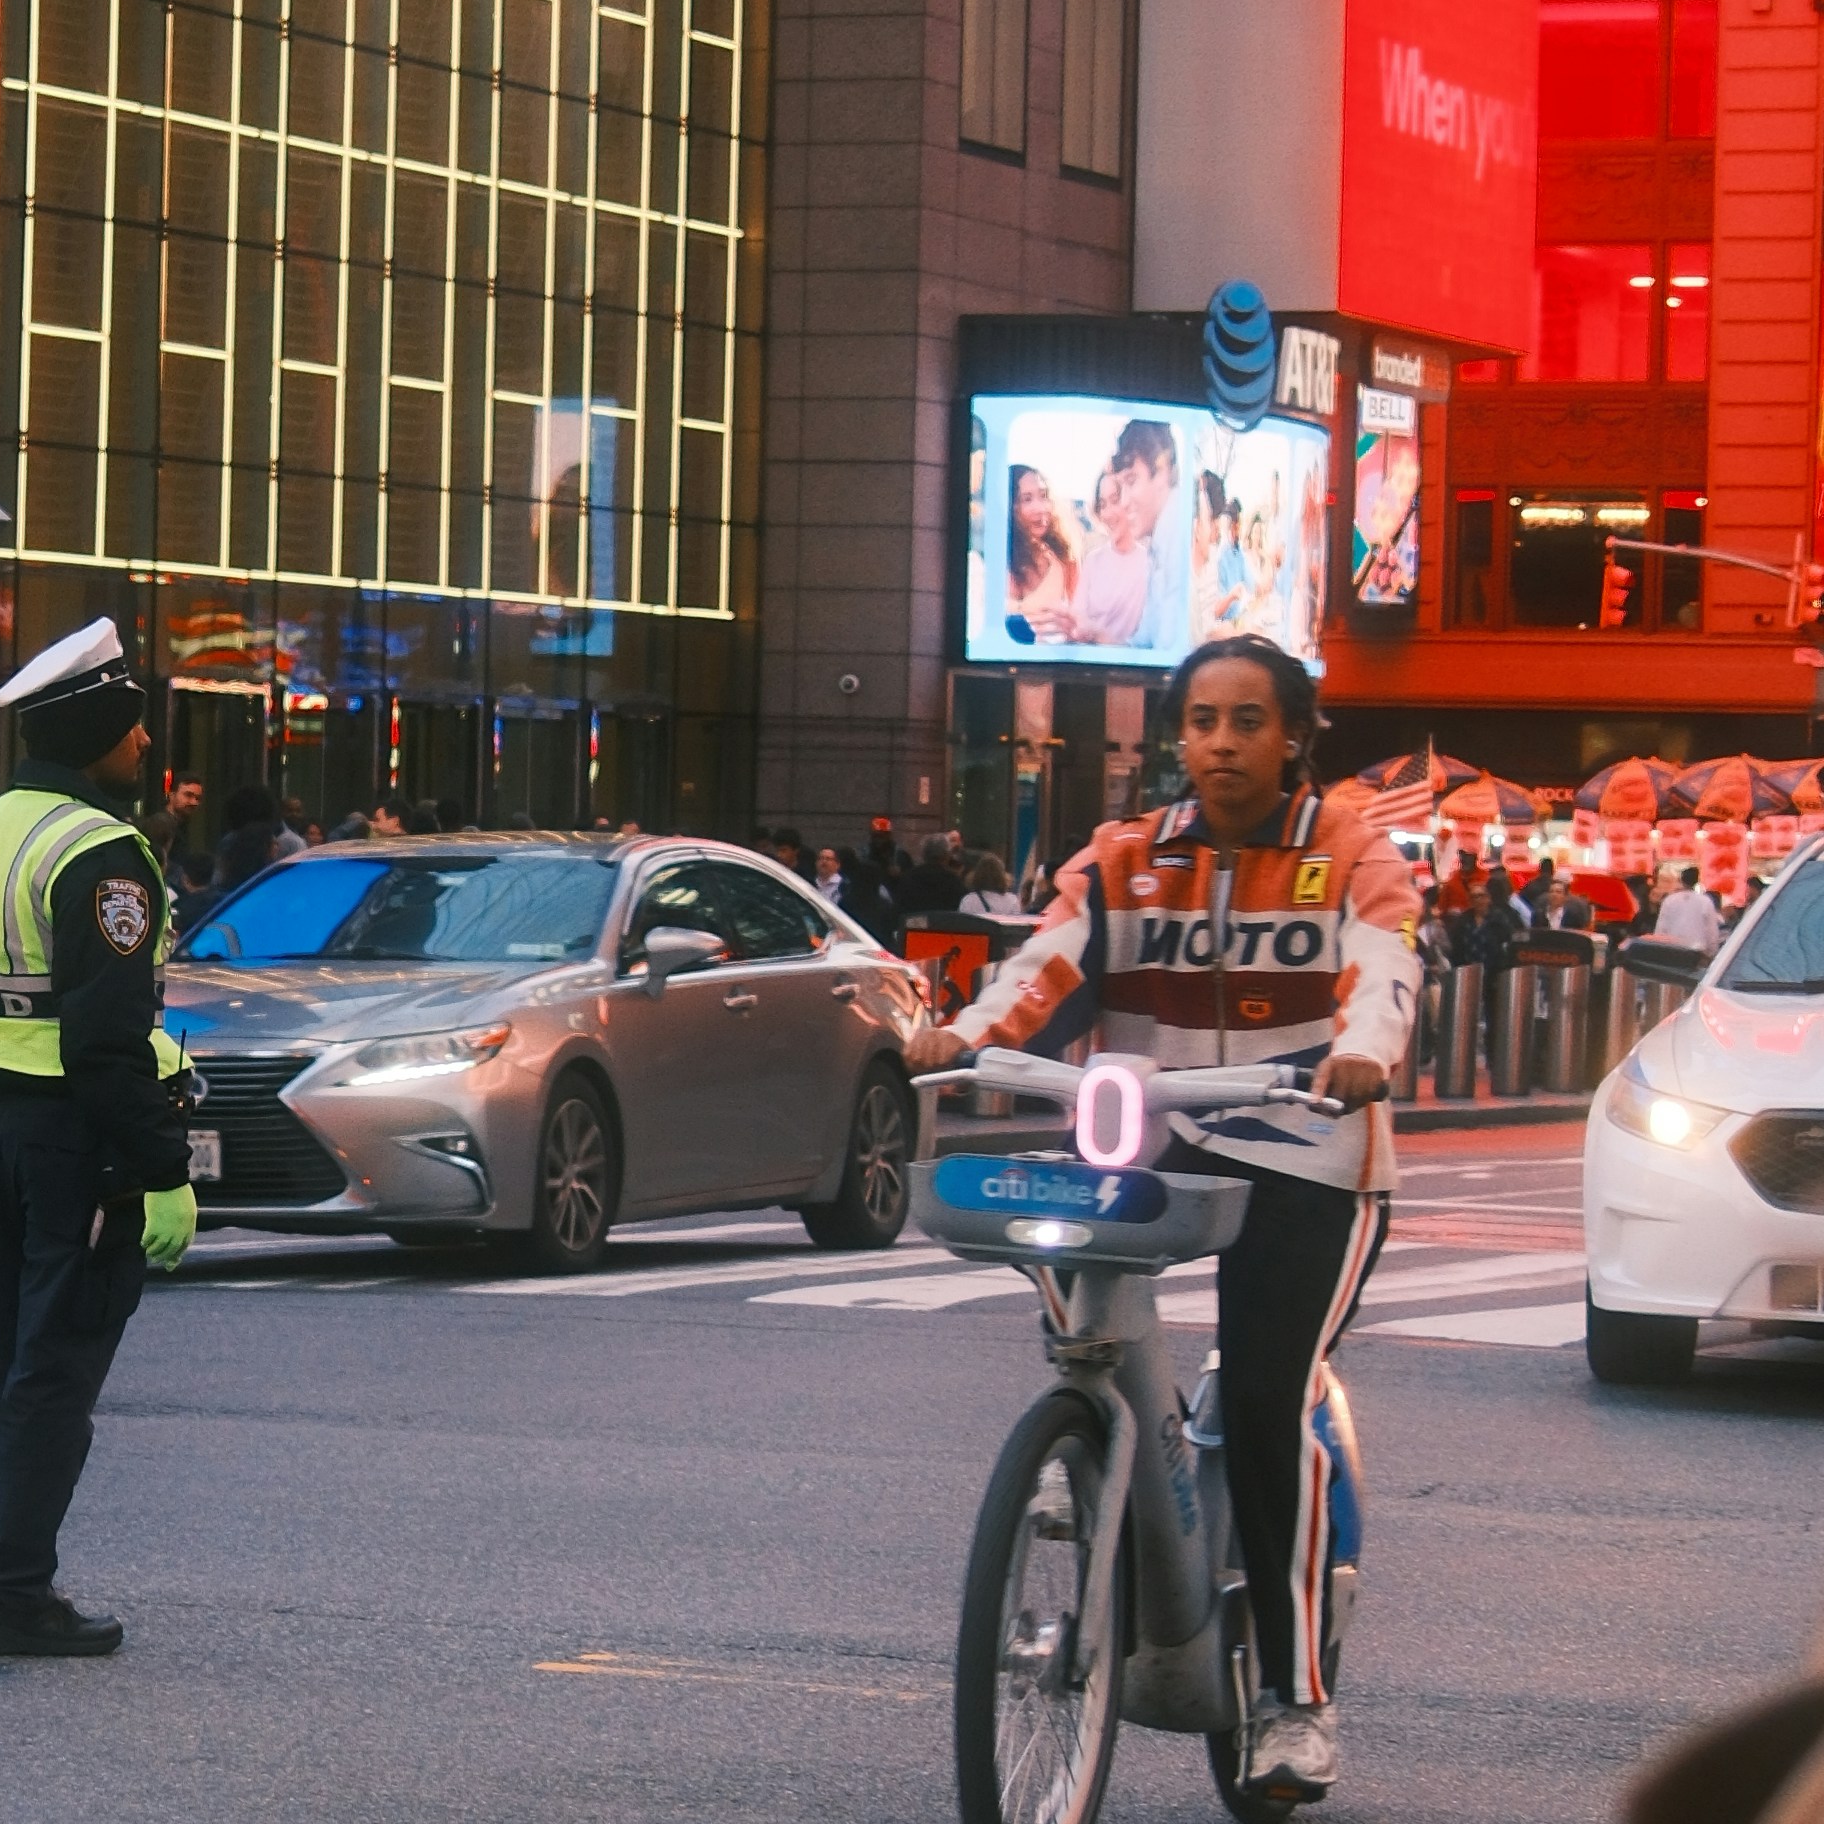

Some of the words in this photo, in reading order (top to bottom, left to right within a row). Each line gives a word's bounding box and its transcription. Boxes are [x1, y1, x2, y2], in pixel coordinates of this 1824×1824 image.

[1379, 37, 1466, 151] When
[1276, 327, 1341, 415] AT&T
[1369, 395, 1406, 421] BELL
[980, 1170, 1028, 1200] citi
[1032, 1172, 1094, 1206] bike
